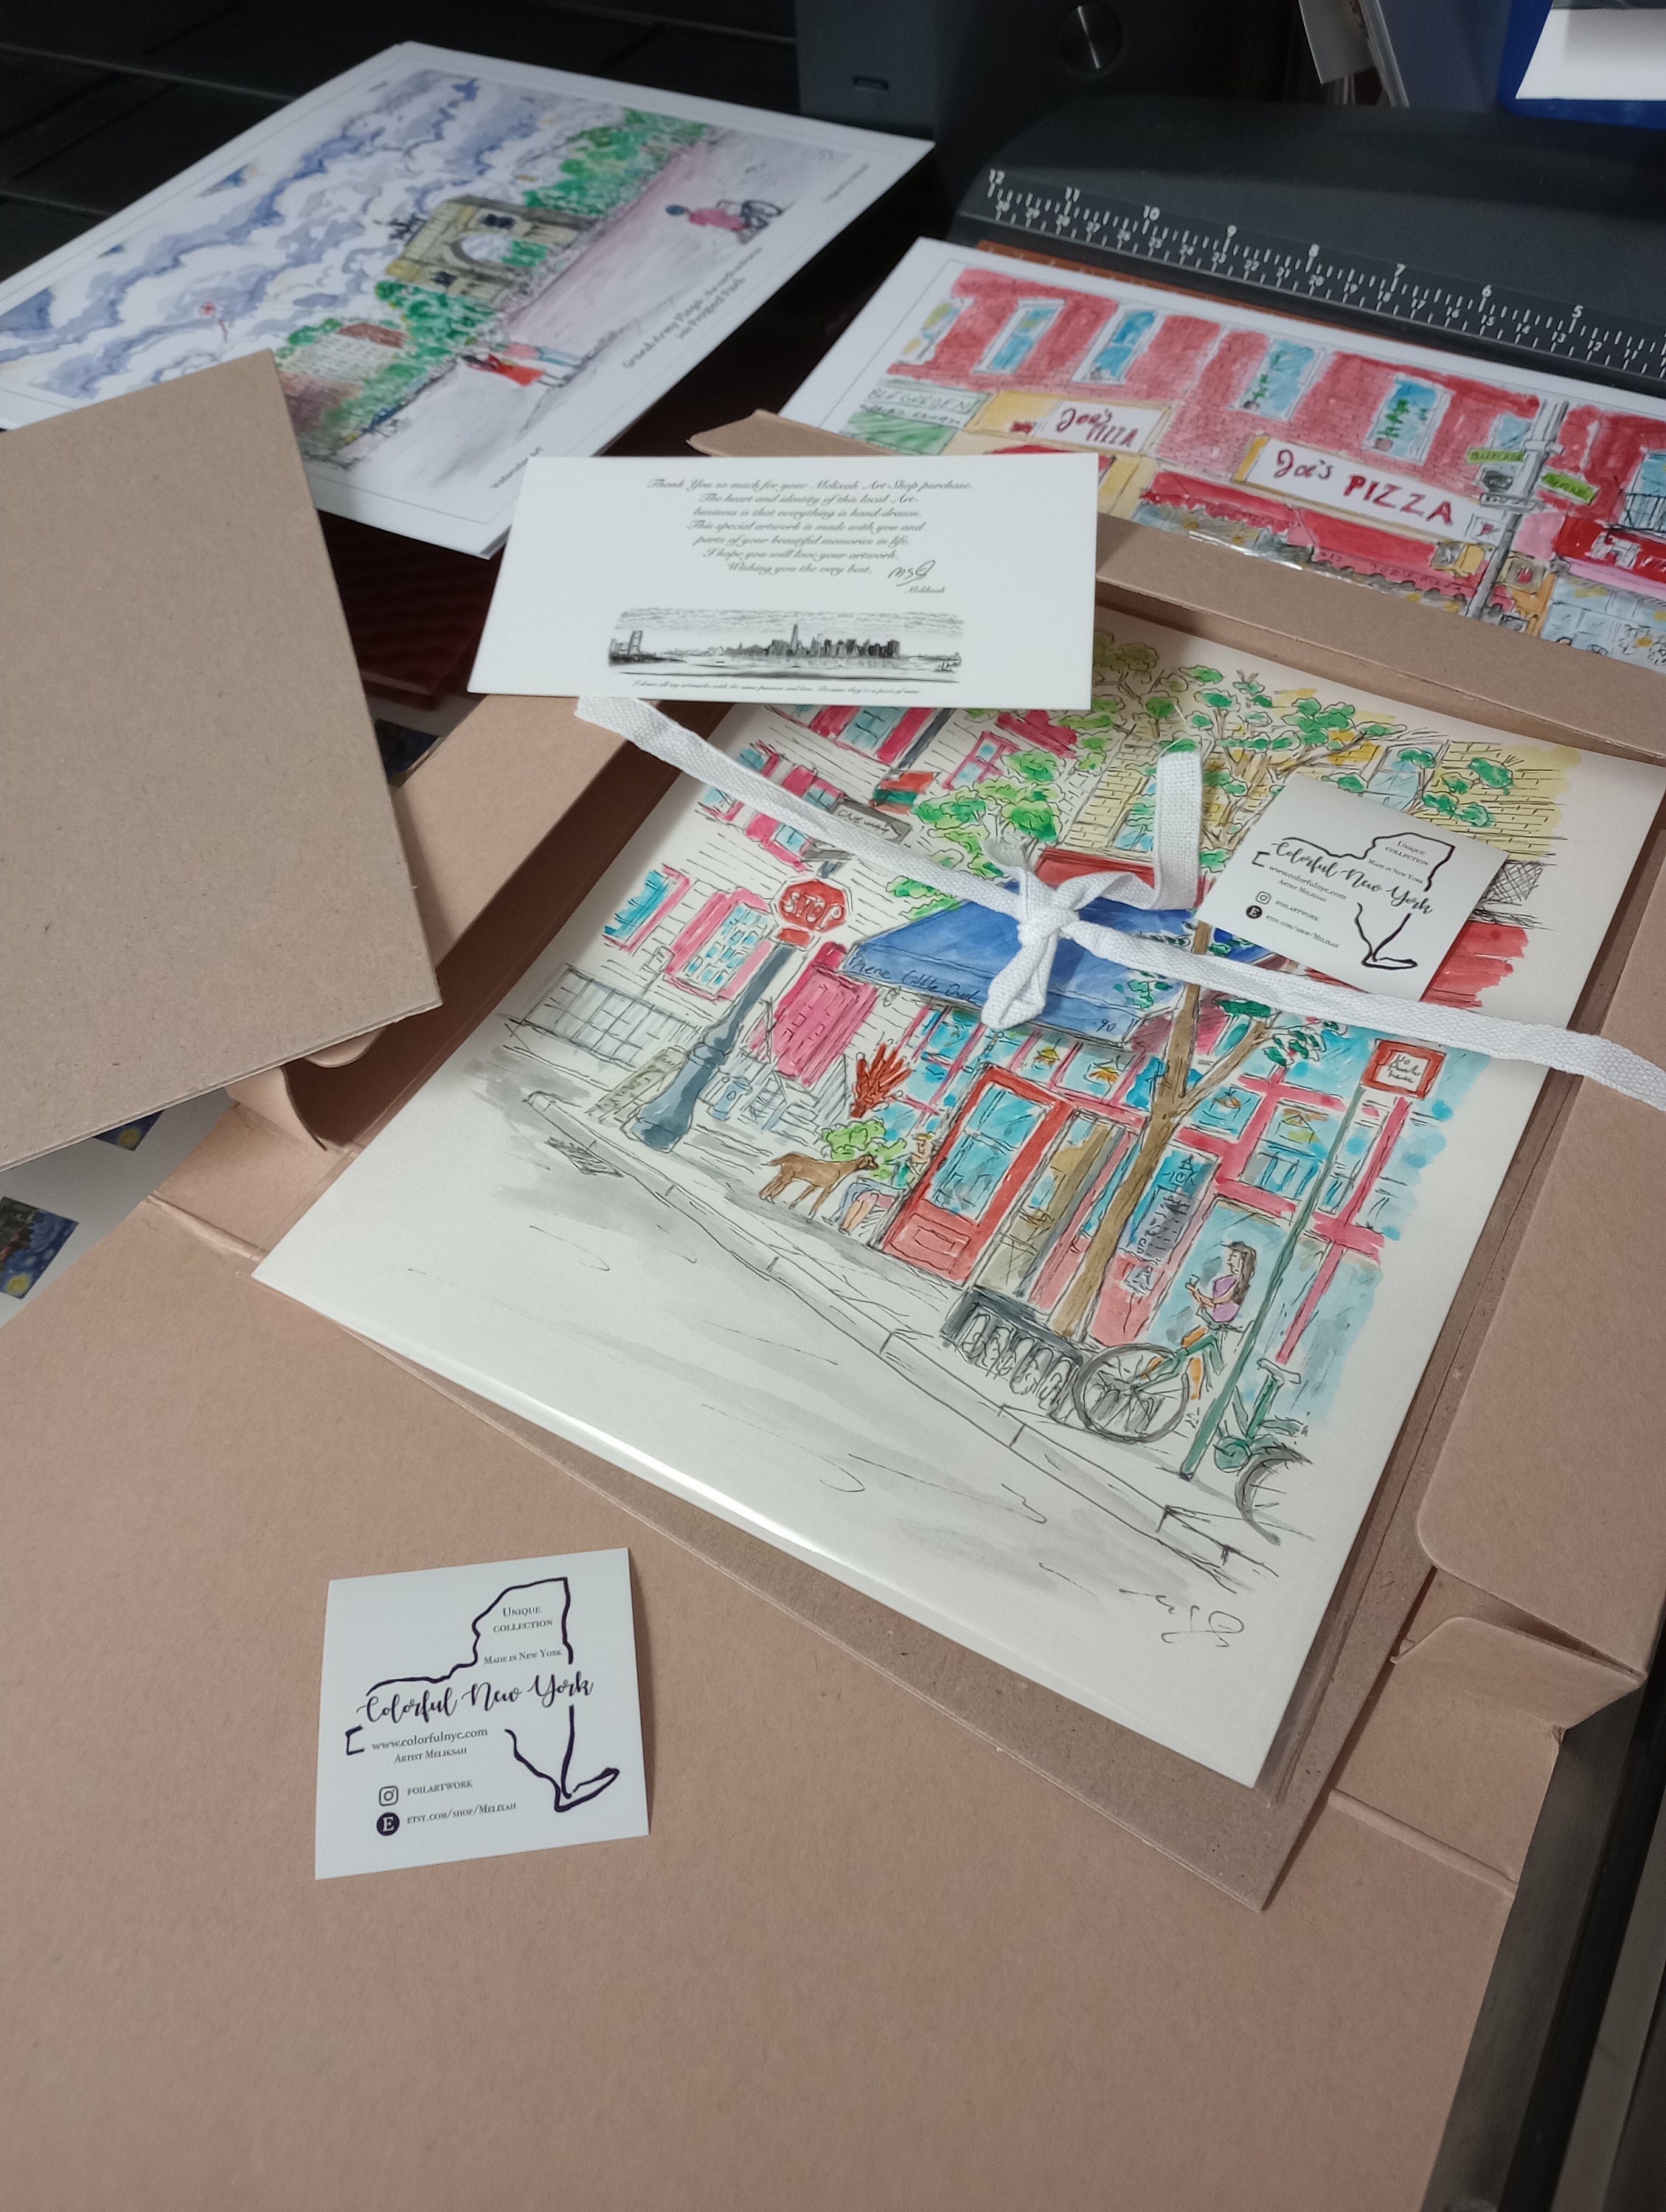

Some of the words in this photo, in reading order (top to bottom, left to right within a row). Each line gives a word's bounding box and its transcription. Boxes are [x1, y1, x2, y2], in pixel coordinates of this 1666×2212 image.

[988, 169, 1005, 184] 12
[1065, 187, 1080, 202] 11
[1143, 205, 1160, 220] 10
[1227, 224, 1238, 237] 9
[1308, 243, 1320, 258] 8
[1397, 263, 1406, 276] 7
[1482, 285, 1492, 298] 6
[1572, 305, 1583, 319] 5
[1412, 298, 1426, 310] 17
[1446, 306, 1460, 319] 16
[1481, 315, 1495, 327] 15
[1516, 323, 1531, 335] 14
[1552, 331, 1566, 343] 13
[1588, 340, 1603, 352] 12
[1624, 348, 1639, 361] 11
[647, 479, 684, 489] Thank
[686, 479, 712, 492] You
[730, 479, 759, 490] much
[755, 480, 779, 492] for
[776, 482, 808, 492] your
[862, 481, 885, 490] Art
[888, 479, 917, 492] Shop
[699, 493, 722, 503] The
[723, 493, 753, 503] heart
[755, 494, 780, 503] and
[780, 494, 820, 506] identity
[822, 494, 839, 506] of
[837, 494, 857, 503] this
[860, 494, 890, 503] local
[1343, 475, 1453, 526] PIZZA
[693, 507, 737, 516] business
[752, 507, 775, 517] that
[778, 507, 835, 520] everything
[838, 509, 847, 518] is
[687, 520, 713, 529] This
[715, 521, 756, 533] special
[754, 521, 801, 530] artwork
[803, 522, 812, 530] is
[815, 521, 847, 531] made
[848, 522, 874, 531] with
[872, 525, 898, 534] you
[901, 522, 926, 531] and
[692, 535, 726, 546] parts
[727, 535, 745, 546] of
[738, 538, 768, 547] your
[771, 535, 822, 547] beautiful
[821, 538, 874, 546] memories
[716, 549, 743, 560] hope
[741, 552, 767, 561] you
[770, 549, 794, 558] will
[794, 549, 818, 559] love
[815, 553, 847, 562] your
[727, 562, 771, 575] Wishing
[768, 566, 796, 575] you
[799, 563, 819, 573] the
[819, 566, 844, 576] very
[1271, 842, 1340, 877] Colorful
[1340, 869, 1383, 892] New
[1386, 886, 1434, 914] York
[782, 891, 844, 932] STOP
[355, 1687, 458, 1723] Colorful
[461, 1681, 523, 1711] New
[527, 1671, 594, 1708] York
[372, 1729, 488, 1750] www.colorfulnyc.com
